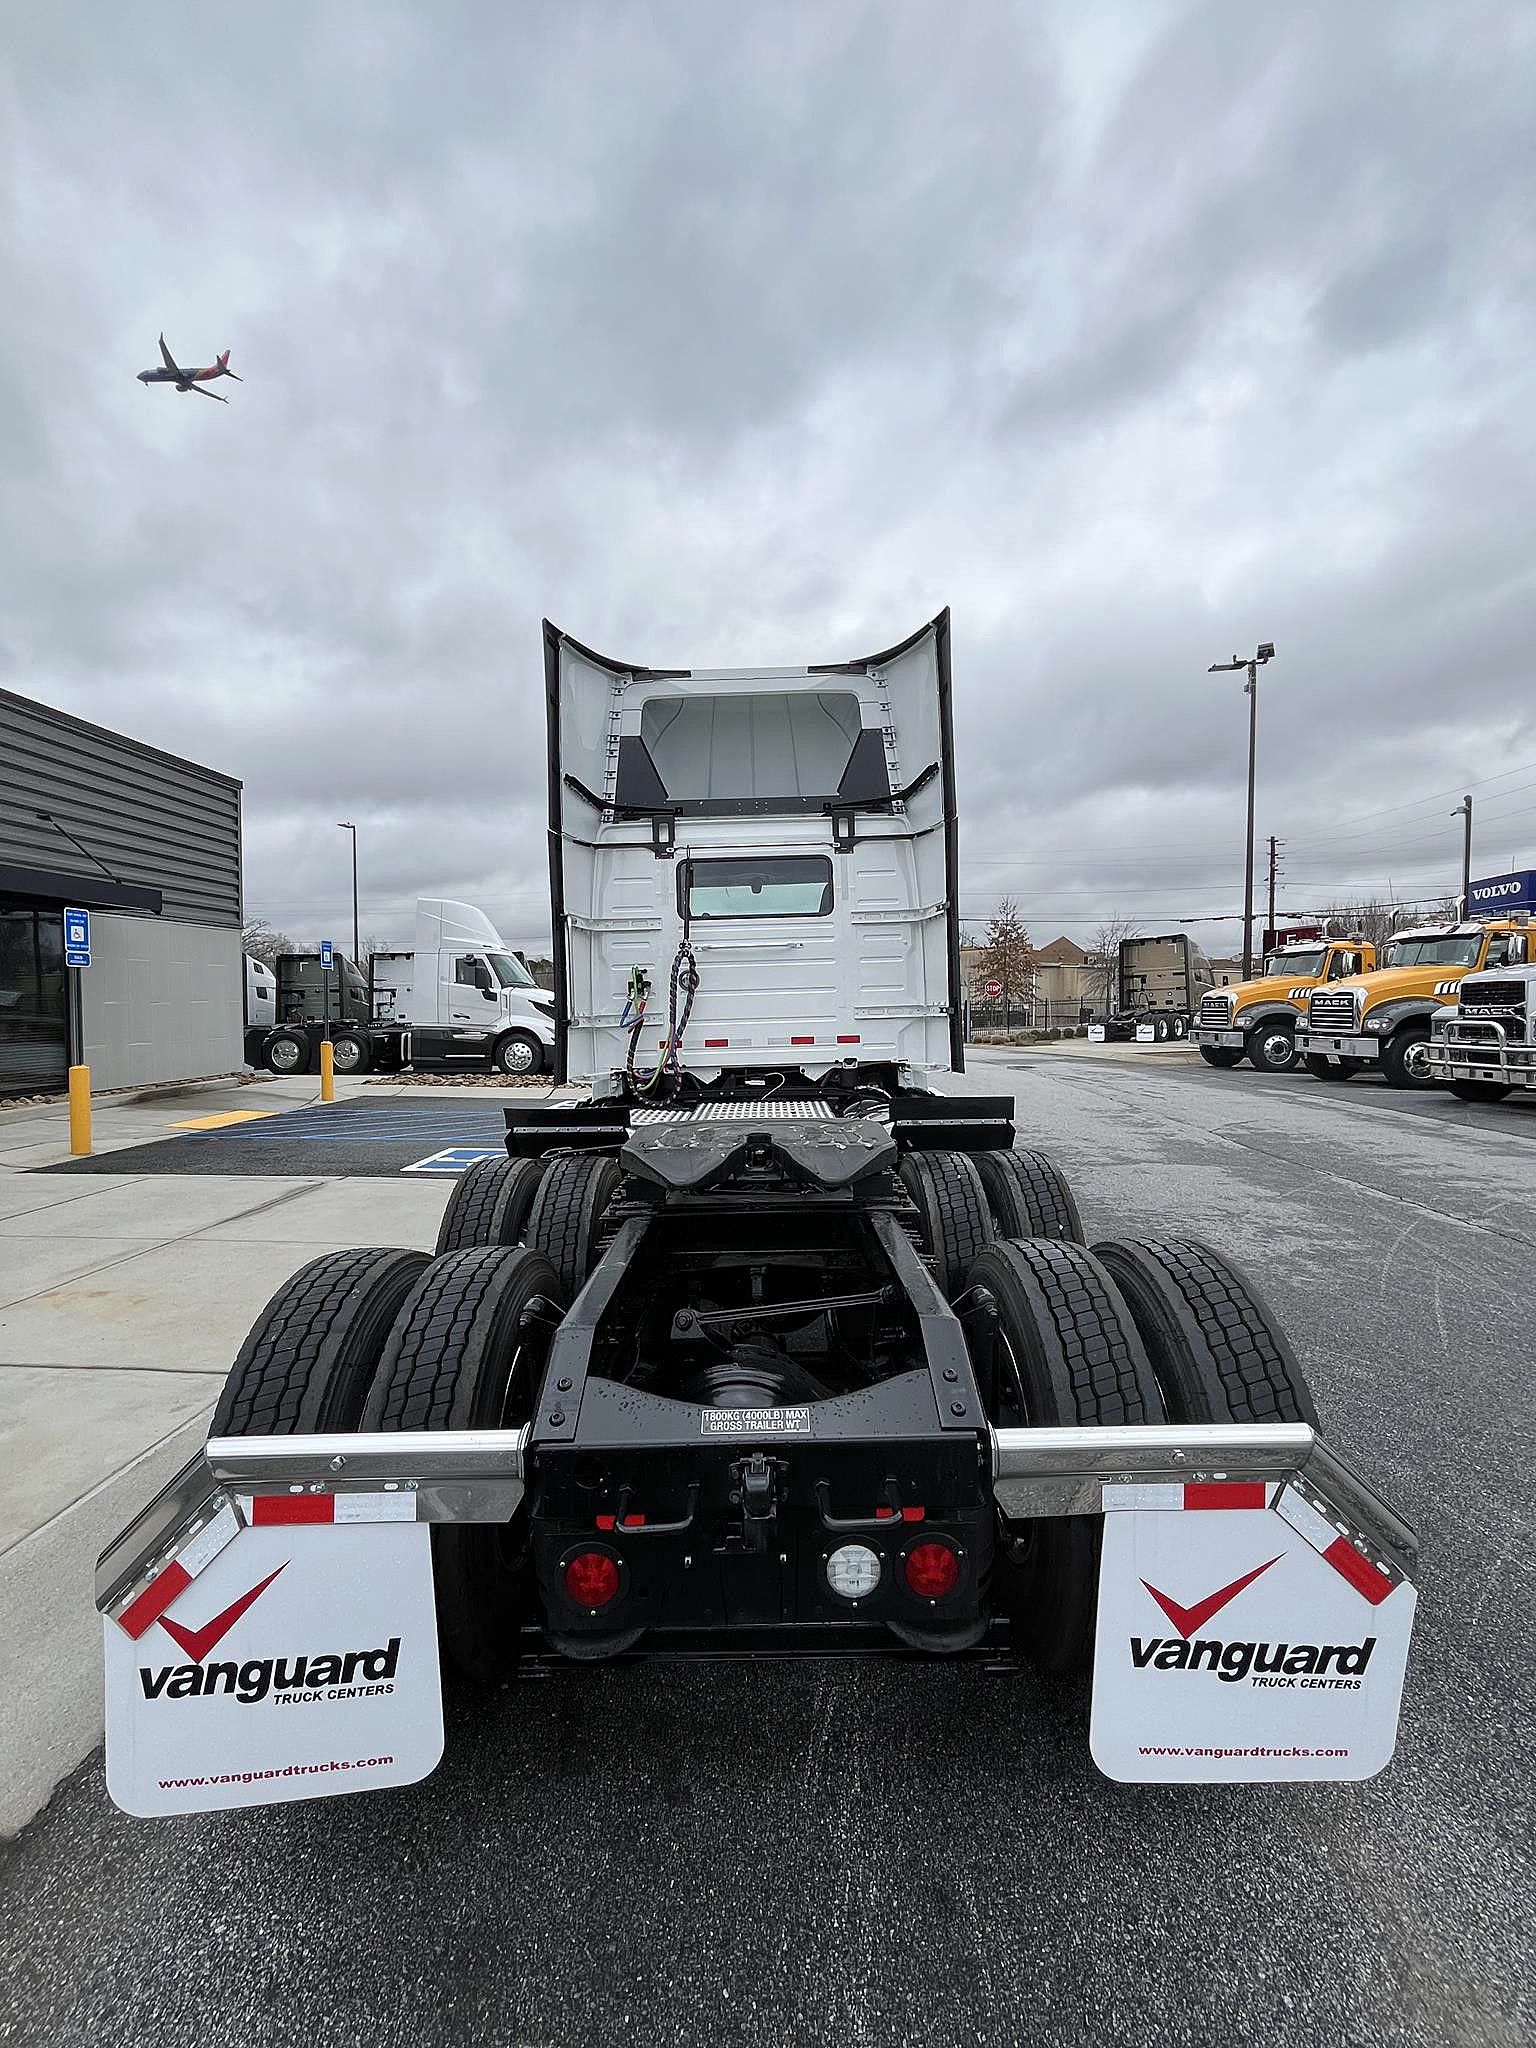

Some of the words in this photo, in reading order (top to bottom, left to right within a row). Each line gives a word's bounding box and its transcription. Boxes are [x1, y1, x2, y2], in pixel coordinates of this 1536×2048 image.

[1472, 881, 1521, 900] VOLVO
[1464, 1007, 1516, 1015] MACK
[705, 1411, 740, 1421] 1800KG
[742, 1410, 784, 1420] (4000LB)
[785, 1410, 807, 1419] MAX
[710, 1421, 742, 1431] GROSS
[744, 1420, 784, 1430] TRAILER
[785, 1419, 801, 1429] WT
[1129, 1637, 1377, 1682] vanguard
[139, 1637, 402, 1703] vanguard
[1251, 1677, 1298, 1689] TRUCK
[1300, 1678, 1362, 1690] CENTERS
[273, 1689, 324, 1706] TRUCK
[327, 1683, 394, 1701] CENTERS
[1138, 1746, 1349, 1759] www.vanguardtrucks.com
[158, 1754, 394, 1789] www.vanguardtrucks.com
